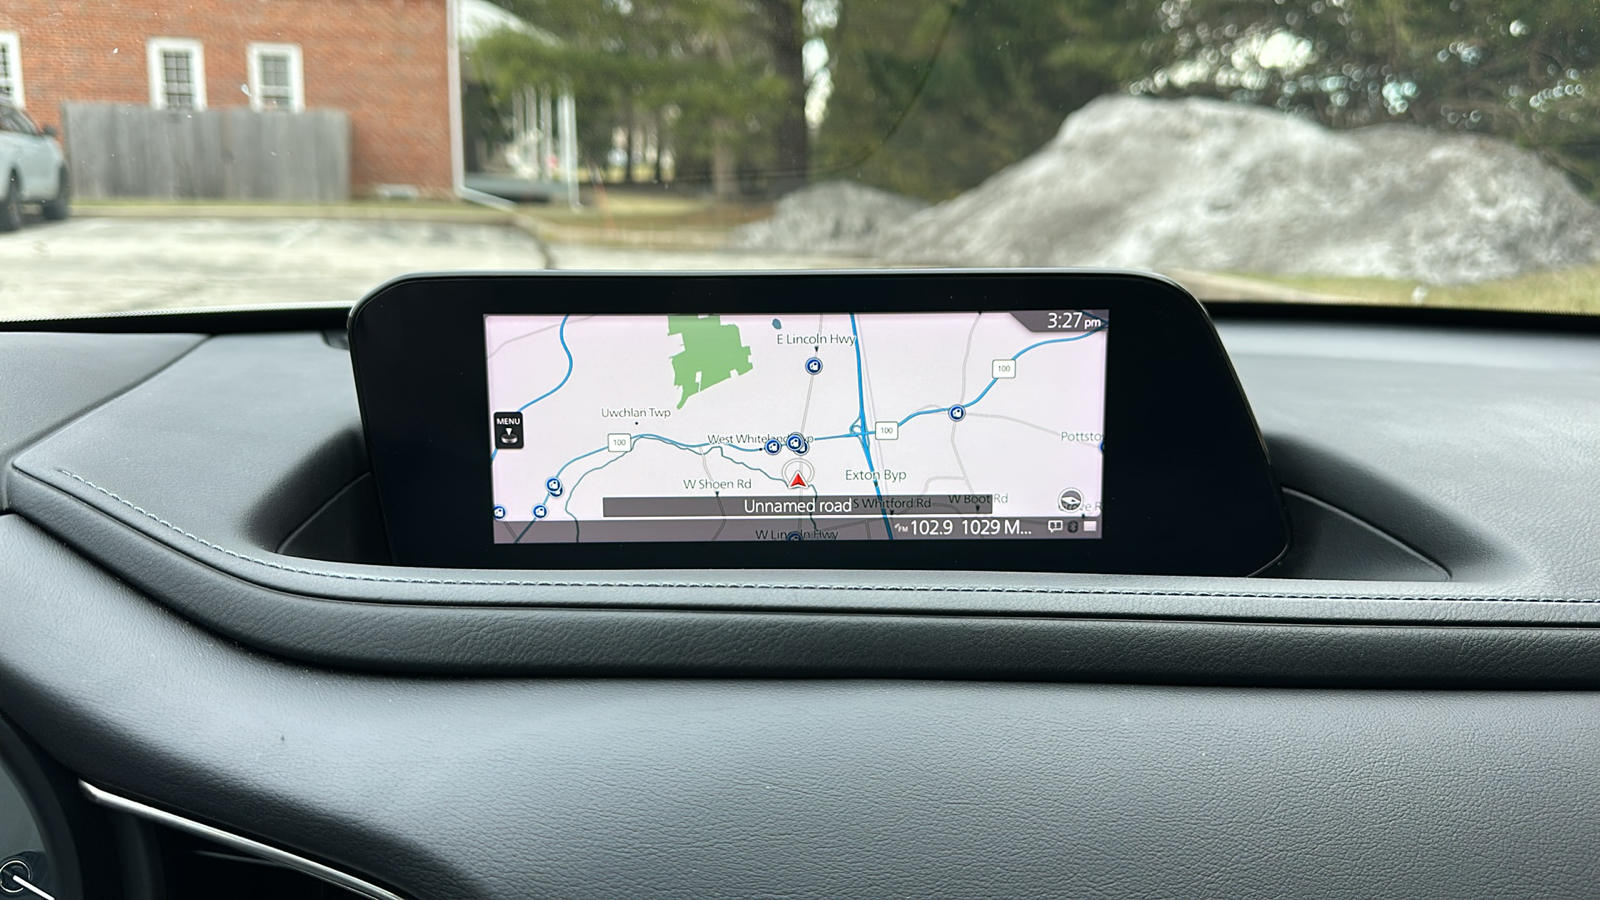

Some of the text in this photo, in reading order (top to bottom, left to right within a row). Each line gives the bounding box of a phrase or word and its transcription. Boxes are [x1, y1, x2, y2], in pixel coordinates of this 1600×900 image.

[1047, 312, 1102, 329] 3:27 pm
[777, 333, 856, 347] E Lincoln Hwy
[601, 408, 671, 419] Uwchlan Twp
[496, 417, 521, 426] MENU
[707, 434, 734, 444] West
[845, 469, 907, 483] Exton Byp
[683, 479, 752, 489] W Shoen Rd
[853, 498, 932, 509] S Whitford Rd
[947, 493, 1009, 504] W Boot Rd
[744, 497, 852, 514] Unnamed road
[911, 519, 954, 535] 102.9
[962, 519, 1000, 535] 1029
[1004, 519, 1032, 535] M...
[755, 529, 839, 541] W Linln Hwy
